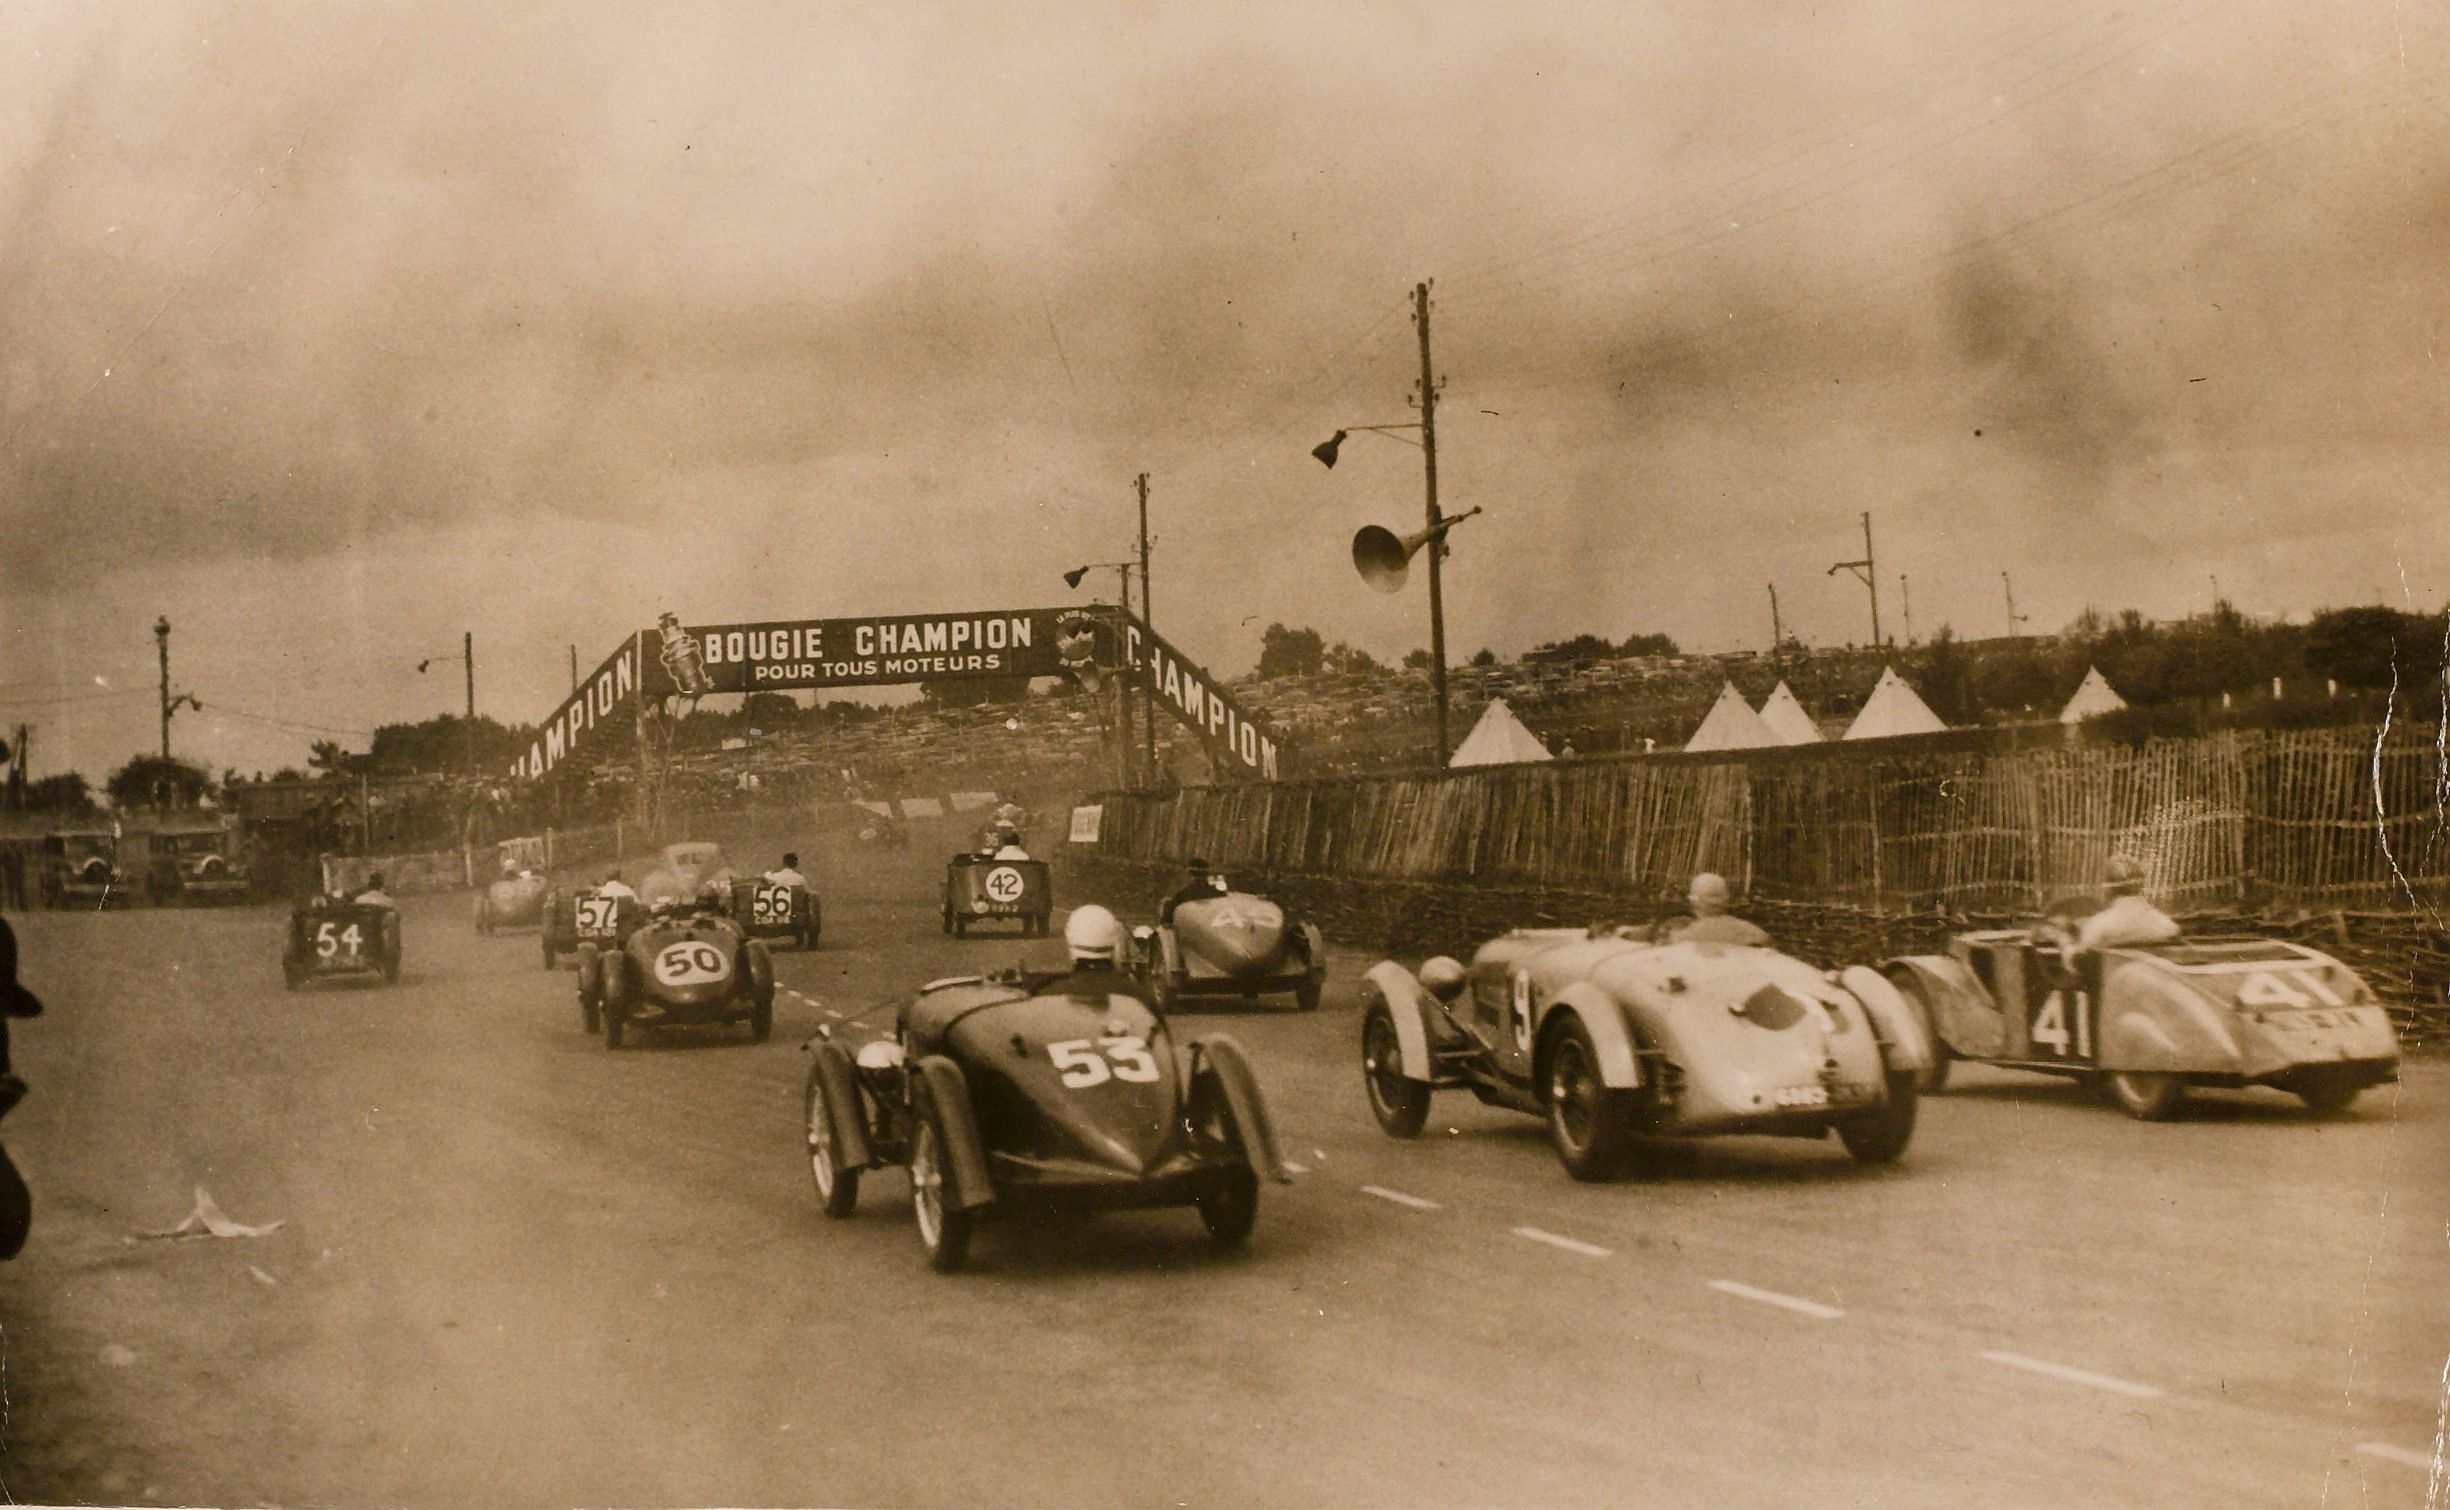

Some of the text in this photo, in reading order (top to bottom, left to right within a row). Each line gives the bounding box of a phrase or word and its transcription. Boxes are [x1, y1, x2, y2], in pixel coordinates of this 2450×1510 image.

[705, 617, 1031, 664] BOUGIE CHAMPION
[756, 654, 1001, 681] POUR TOUS MOTEURS
[755, 886, 790, 917] 56
[989, 873, 1019, 896] 42
[579, 896, 615, 929] 57
[317, 922, 363, 957] 54
[664, 948, 721, 977] 50
[2236, 969, 2346, 1007] 41
[2031, 990, 2092, 1058] 41
[1047, 1036, 1160, 1089] 53
